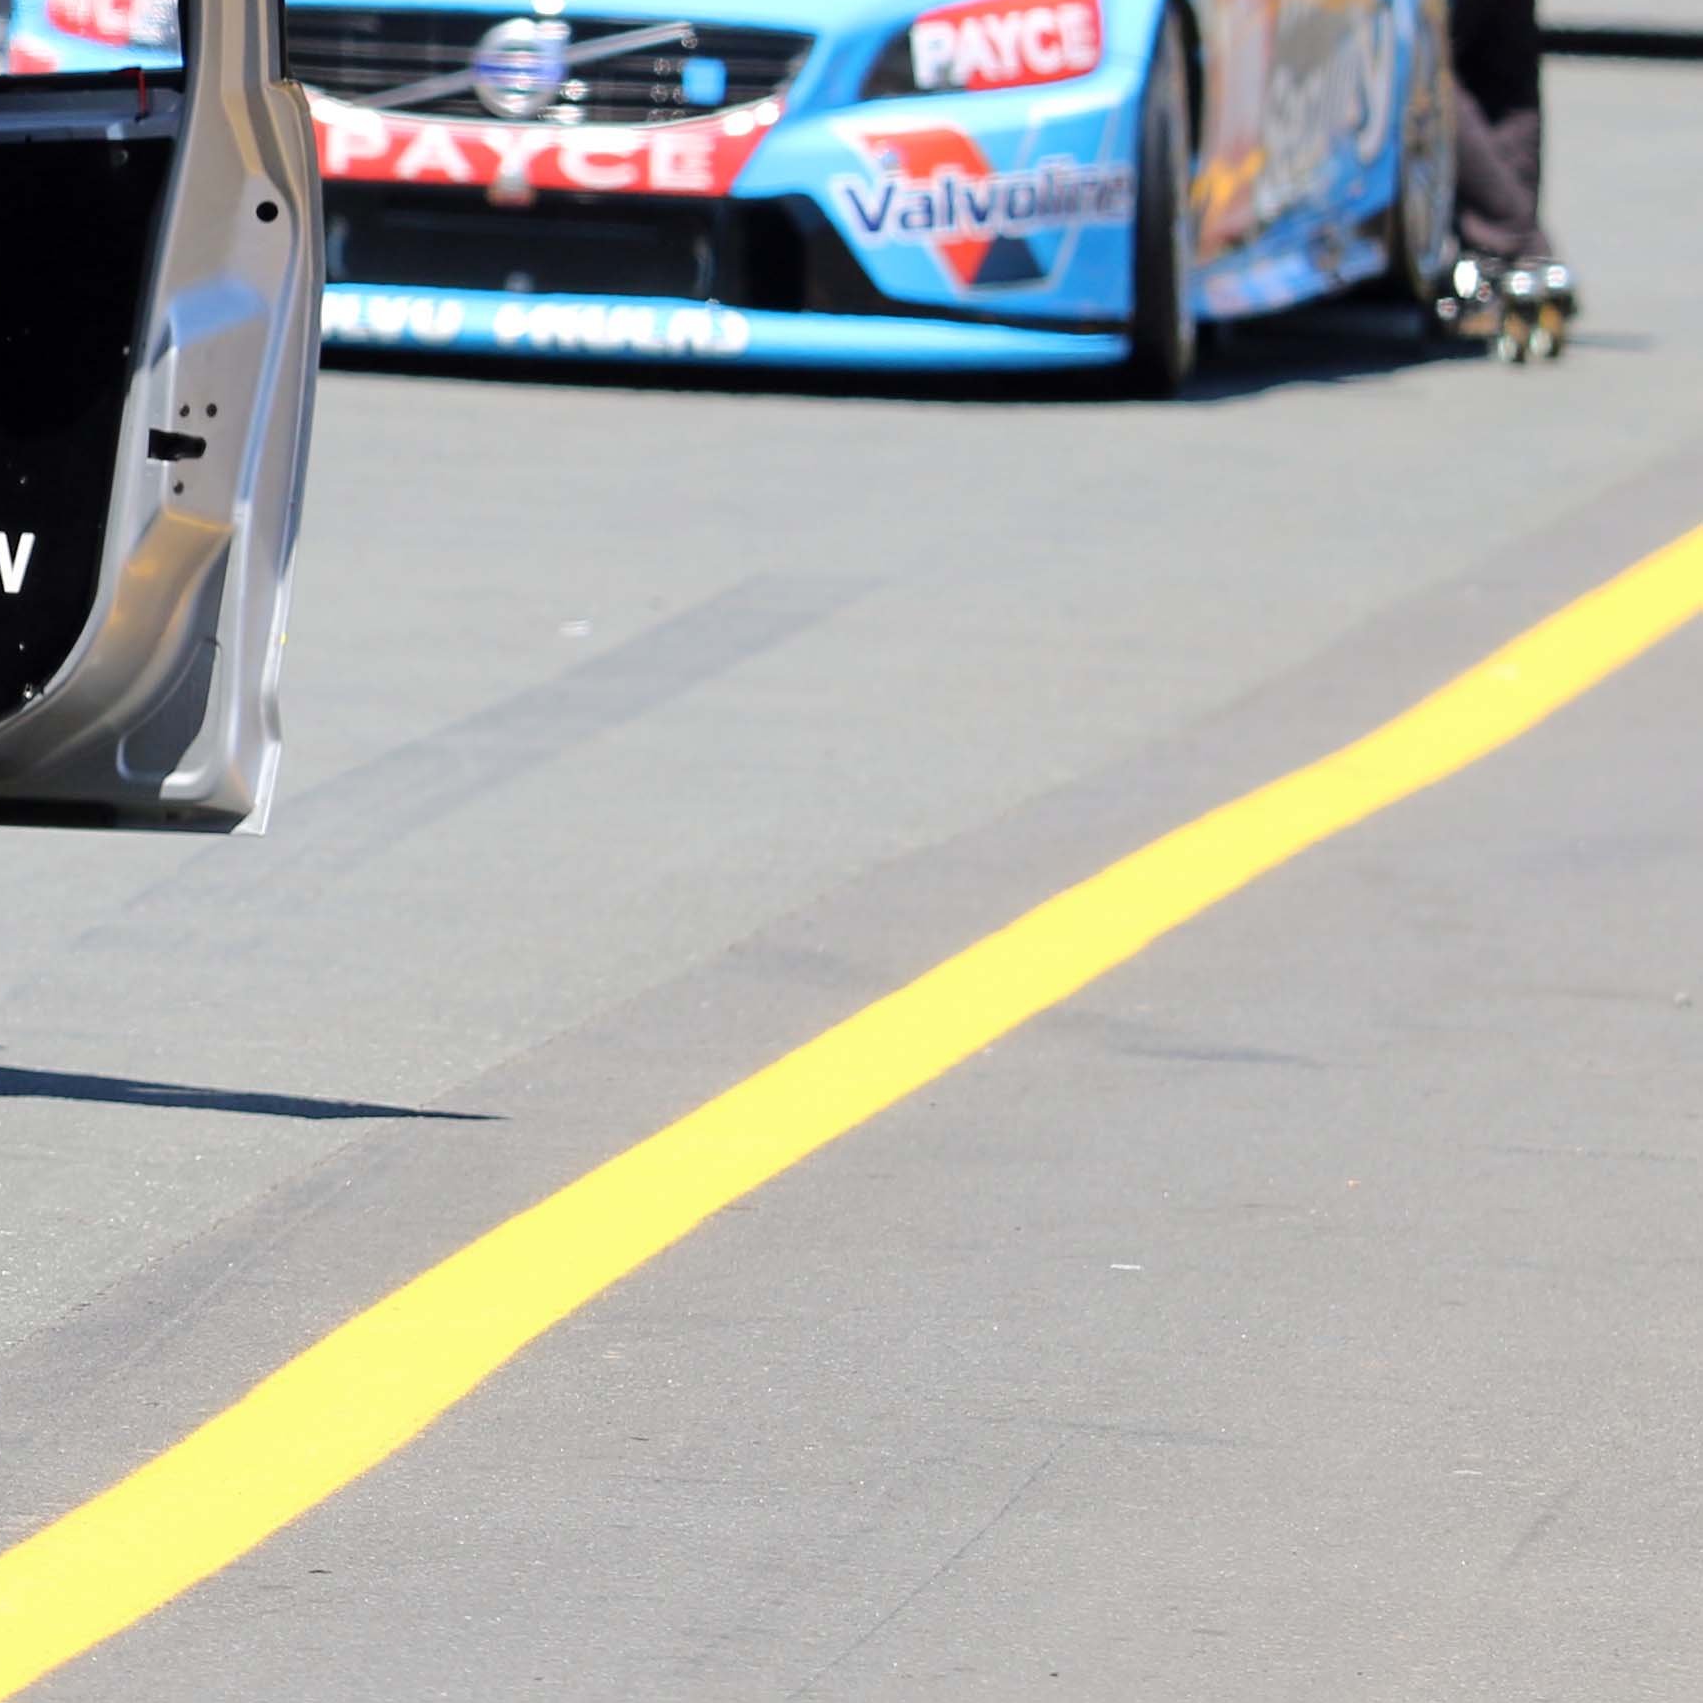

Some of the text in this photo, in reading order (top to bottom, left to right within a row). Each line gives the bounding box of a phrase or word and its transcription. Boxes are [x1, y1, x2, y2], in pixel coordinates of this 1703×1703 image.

[911, 0, 1103, 90] PAYCE
[325, 122, 717, 192] PAYCE
[841, 162, 1135, 238] Valvoline
